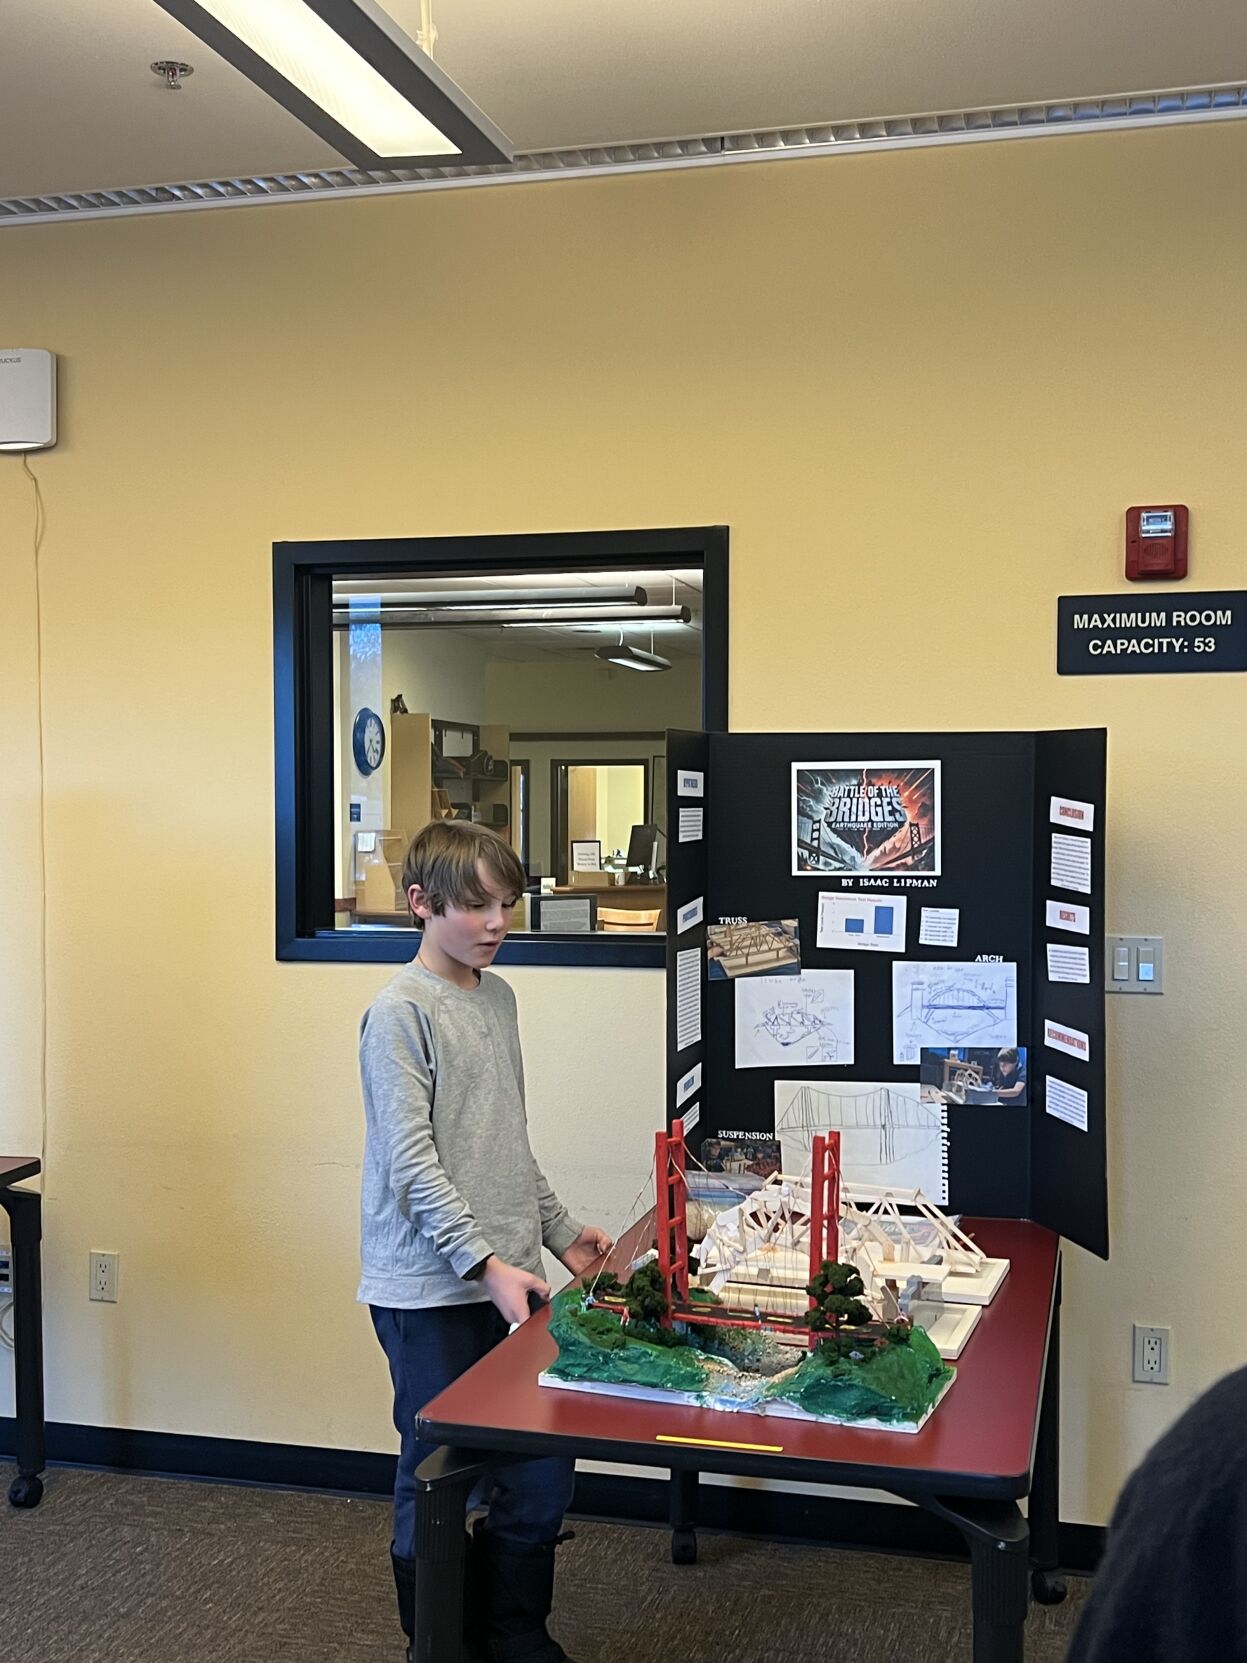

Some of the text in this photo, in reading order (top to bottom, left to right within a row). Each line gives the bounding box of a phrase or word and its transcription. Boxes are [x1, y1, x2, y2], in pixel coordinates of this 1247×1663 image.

[1073, 610, 1232, 629] MAXIMUM ROOM
[1088, 637, 1216, 655] CAPACITY: 53
[831, 785, 900, 798] BATTLE OF THE
[824, 797, 908, 822] BRIDGES
[832, 821, 899, 829] EARTHQUAKE EDITION
[841, 878, 938, 888] BY ISAAC LIPMAN
[718, 916, 748, 925] TRUSS
[975, 954, 1004, 963] ARCH
[717, 1129, 774, 1140] SUSPENSION
